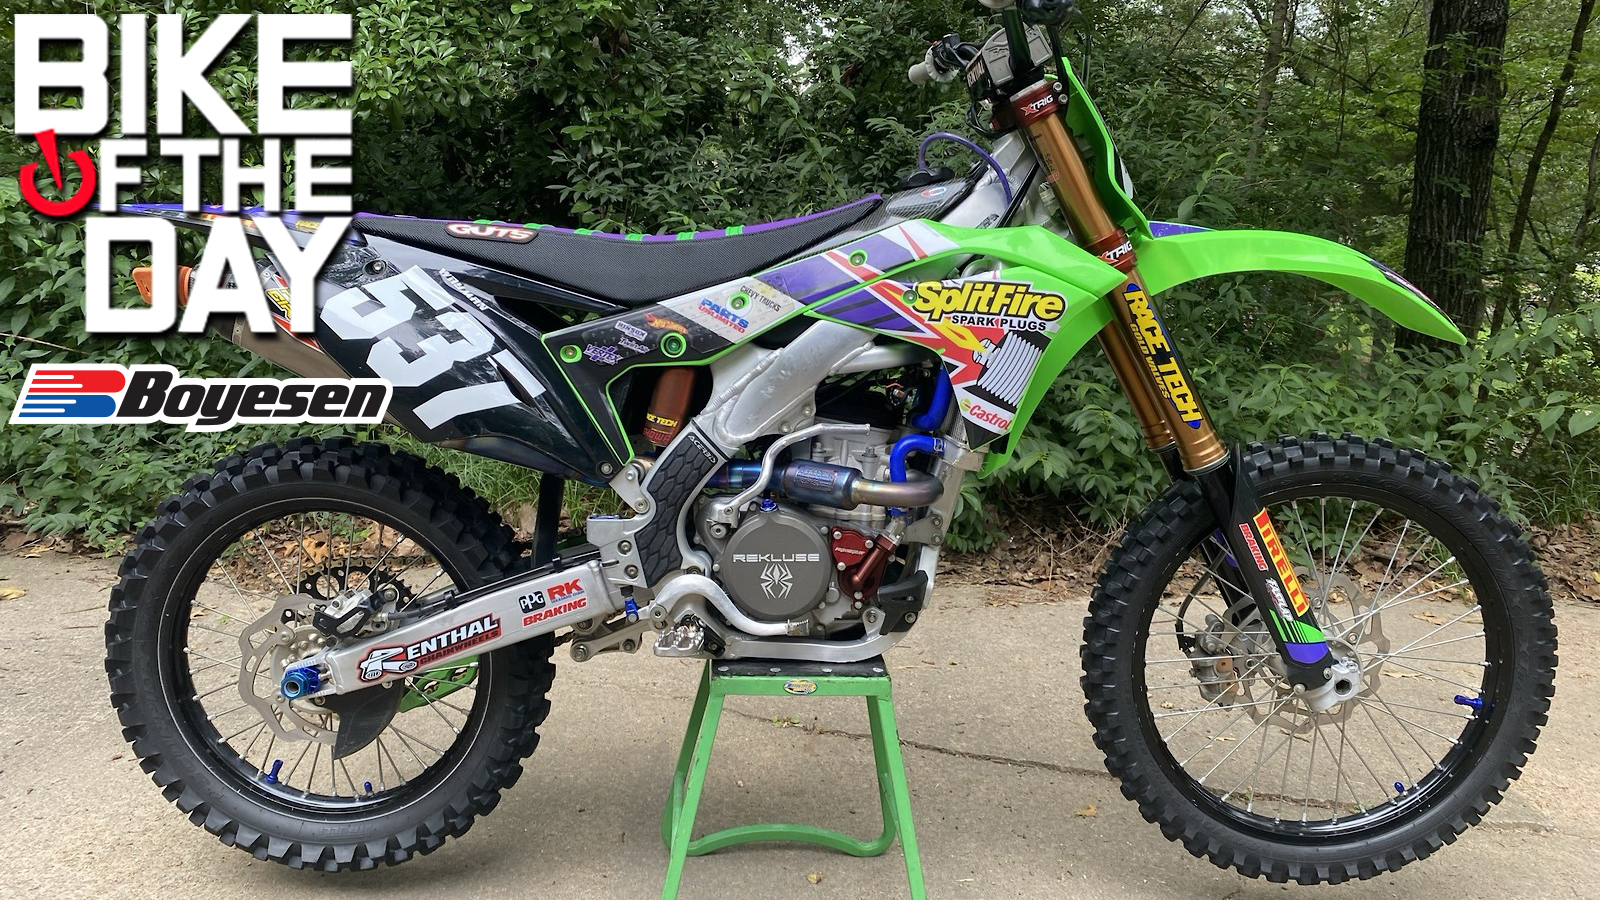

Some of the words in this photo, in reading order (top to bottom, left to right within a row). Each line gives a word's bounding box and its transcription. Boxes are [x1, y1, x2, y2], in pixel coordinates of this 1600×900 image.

[1021, 94, 1053, 116] XTRIG
[448, 223, 534, 240] GUTS
[740, 285, 759, 300] CHEVY
[760, 295, 782, 312] TRUCKS
[914, 280, 1065, 321] SplitFire
[698, 304, 746, 334] UNLIMITED
[701, 298, 750, 329] PARTS
[952, 315, 996, 327] SPARK
[1000, 319, 1047, 331] PLUGS
[319, 265, 546, 430] 537
[585, 344, 621, 362] VERTEX
[1123, 290, 1171, 355] RACE
[1158, 356, 1203, 422] TECH
[1129, 323, 1150, 355] GOLD
[1146, 356, 1170, 399] VALVES
[657, 417, 678, 427] TECH
[970, 404, 1013, 431] Castrol
[732, 553, 820, 563] REKLUSE
[1239, 523, 1268, 571] BRAKING
[1253, 507, 1310, 616] PIRELLI
[519, 593, 544, 610] PPG
[547, 578, 584, 601] RK
[523, 598, 587, 627] BRAKING
[360, 616, 499, 681] RENTHAL
[420, 630, 500, 665] CHAINWHEELS
